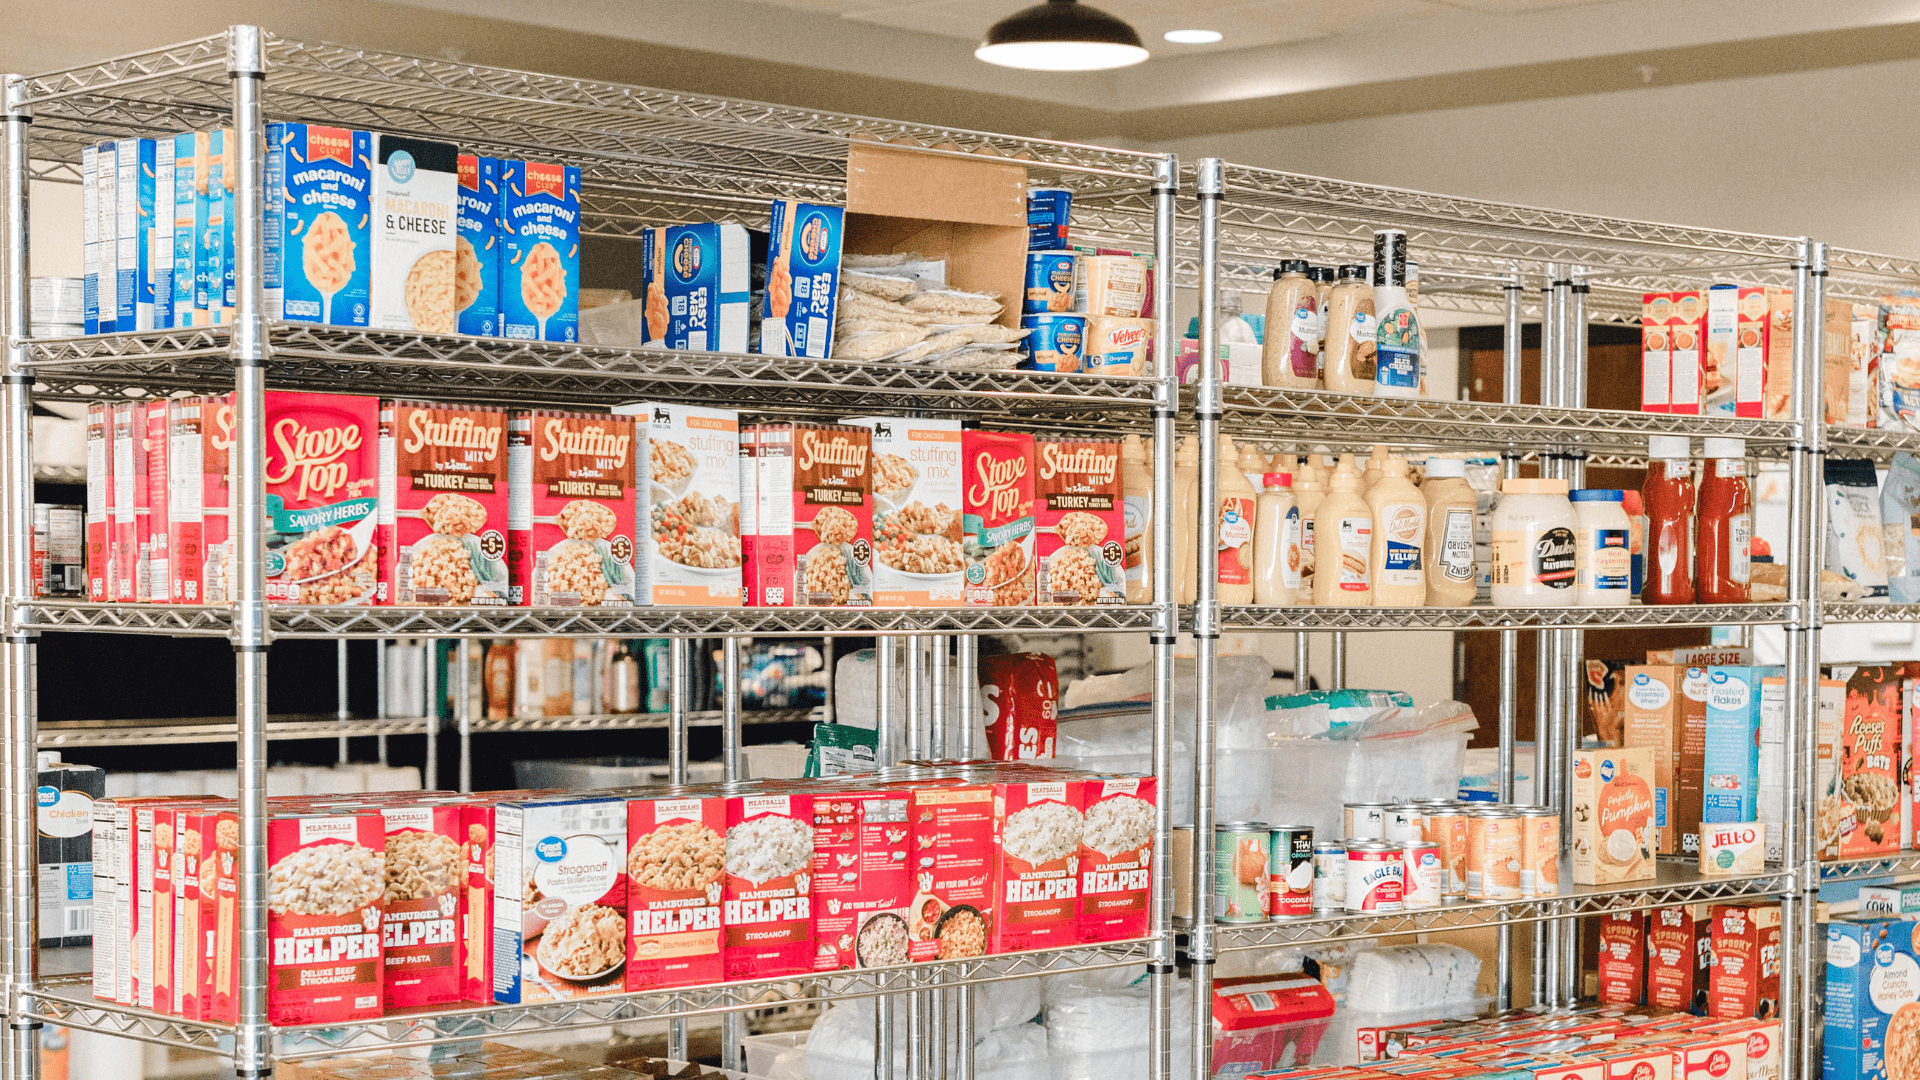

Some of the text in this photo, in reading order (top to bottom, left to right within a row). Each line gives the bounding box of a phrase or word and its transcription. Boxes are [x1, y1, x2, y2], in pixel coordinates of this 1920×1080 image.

[293, 169, 366, 192] macaroni
[321, 182, 338, 191] and
[302, 189, 356, 210] cheese
[385, 197, 449, 219] MACARONI
[513, 203, 576, 224] macaroni
[386, 214, 446, 235] & CHEESE
[537, 215, 552, 223] and
[521, 221, 567, 240] cheese
[677, 299, 685, 312] 18
[404, 409, 502, 461] Stuffing
[922, 432, 945, 440] CHICKEN
[540, 419, 630, 468] Stuffing
[689, 434, 734, 457] stuffing
[266, 418, 362, 484] Stove
[464, 450, 484, 463] MIX
[799, 431, 868, 476] Stuffing
[910, 446, 957, 467] stuffing
[434, 461, 444, 471] by
[596, 458, 614, 470] MIX
[706, 453, 727, 469] mix
[1040, 443, 1118, 484] Stuffing
[568, 469, 577, 478] by
[841, 467, 855, 478] MIX
[927, 463, 950, 479] mix
[296, 456, 348, 501] Top
[424, 473, 465, 489] TURKEY
[969, 451, 1028, 507] Stove
[1088, 475, 1104, 486] MIX
[558, 481, 596, 496] TURKEY
[1065, 485, 1072, 494] by
[813, 489, 842, 502] TURKEY
[1056, 496, 1089, 508] TURKEY
[988, 484, 1020, 521] Top
[289, 502, 370, 528] SAVORY HERBS
[987, 521, 1031, 543] SAVORY HERBS
[1225, 530, 1248, 540] Mustard
[488, 538, 496, 552] 5
[617, 543, 625, 556] 5
[1447, 541, 1473, 549] MUSTARD
[858, 545, 865, 559] 5
[1109, 547, 1116, 560] 5
[1389, 552, 1418, 561] YELLOW
[1452, 551, 1470, 559] YELLOW
[1451, 565, 1470, 576] HEINZ
[1686, 652, 1741, 665] LARGE SIZE
[1711, 686, 1745, 696] Frosted
[1713, 696, 1742, 705] Flakes
[1850, 714, 1885, 735] Reese's
[1854, 733, 1883, 754] Puffs
[1031, 786, 1063, 795] MEATBALLS
[1107, 781, 1137, 790] MEATBALLS
[748, 799, 786, 807] MEATBALLS
[1608, 789, 1635, 806] Perfectly
[49, 809, 89, 819] Chicken
[658, 805, 678, 813] BLACK
[1602, 796, 1651, 826] Pumpkin
[385, 813, 429, 822] MEATBALLS
[305, 823, 352, 832] MEATBALLS
[537, 841, 562, 853] Great
[558, 862, 607, 877] Stroganoff
[1095, 861, 1139, 872] HAMBURGER
[547, 875, 607, 886] Pasta Skillet Dinner
[1020, 870, 1067, 880] HAMBURGER
[1082, 869, 1149, 894] HELPER
[1363, 866, 1391, 885] EAGLE
[935, 881, 945, 890] ADD
[946, 880, 957, 889] YOUR
[957, 879, 969, 888] OWN
[1006, 878, 1078, 903] HELPER
[739, 888, 796, 901] HAMBURGER
[1280, 896, 1309, 904] coconut
[649, 897, 706, 910] HAMBURGER
[842, 902, 853, 910] ADD
[853, 901, 865, 909] YOUR
[865, 900, 877, 908] OWN
[1098, 898, 1133, 908] STROGANOFF
[1866, 901, 1893, 913] CORN
[384, 910, 440, 922] AMBURGER
[724, 896, 810, 926] HELPER
[1023, 908, 1061, 918] STROGANOFF
[633, 906, 721, 936] HELPER
[1722, 917, 1746, 928] FROOT
[293, 924, 362, 938] HAMBURGER
[383, 919, 456, 948] ELPER
[745, 930, 791, 941] STROGANOFF
[1606, 925, 1639, 938] SPOOKY
[1723, 925, 1745, 935] LOOPS
[1655, 930, 1689, 944] SPOOKY
[274, 933, 380, 966] HELPER
[663, 938, 715, 950] SOUTHWEST PASTA
[1716, 938, 1752, 951] SPOOKY
[385, 955, 431, 966] BEEF PASTA
[301, 966, 356, 979] DELUXE BEEF
[1883, 969, 1908, 979] Almond
[300, 974, 356, 987] STROGANOFF
[1882, 978, 1908, 990] Crunchy
[1878, 988, 1914, 1001] Honey Oats
[1713, 1053, 1726, 1063] Betty
[1636, 1065, 1651, 1076] Betty
